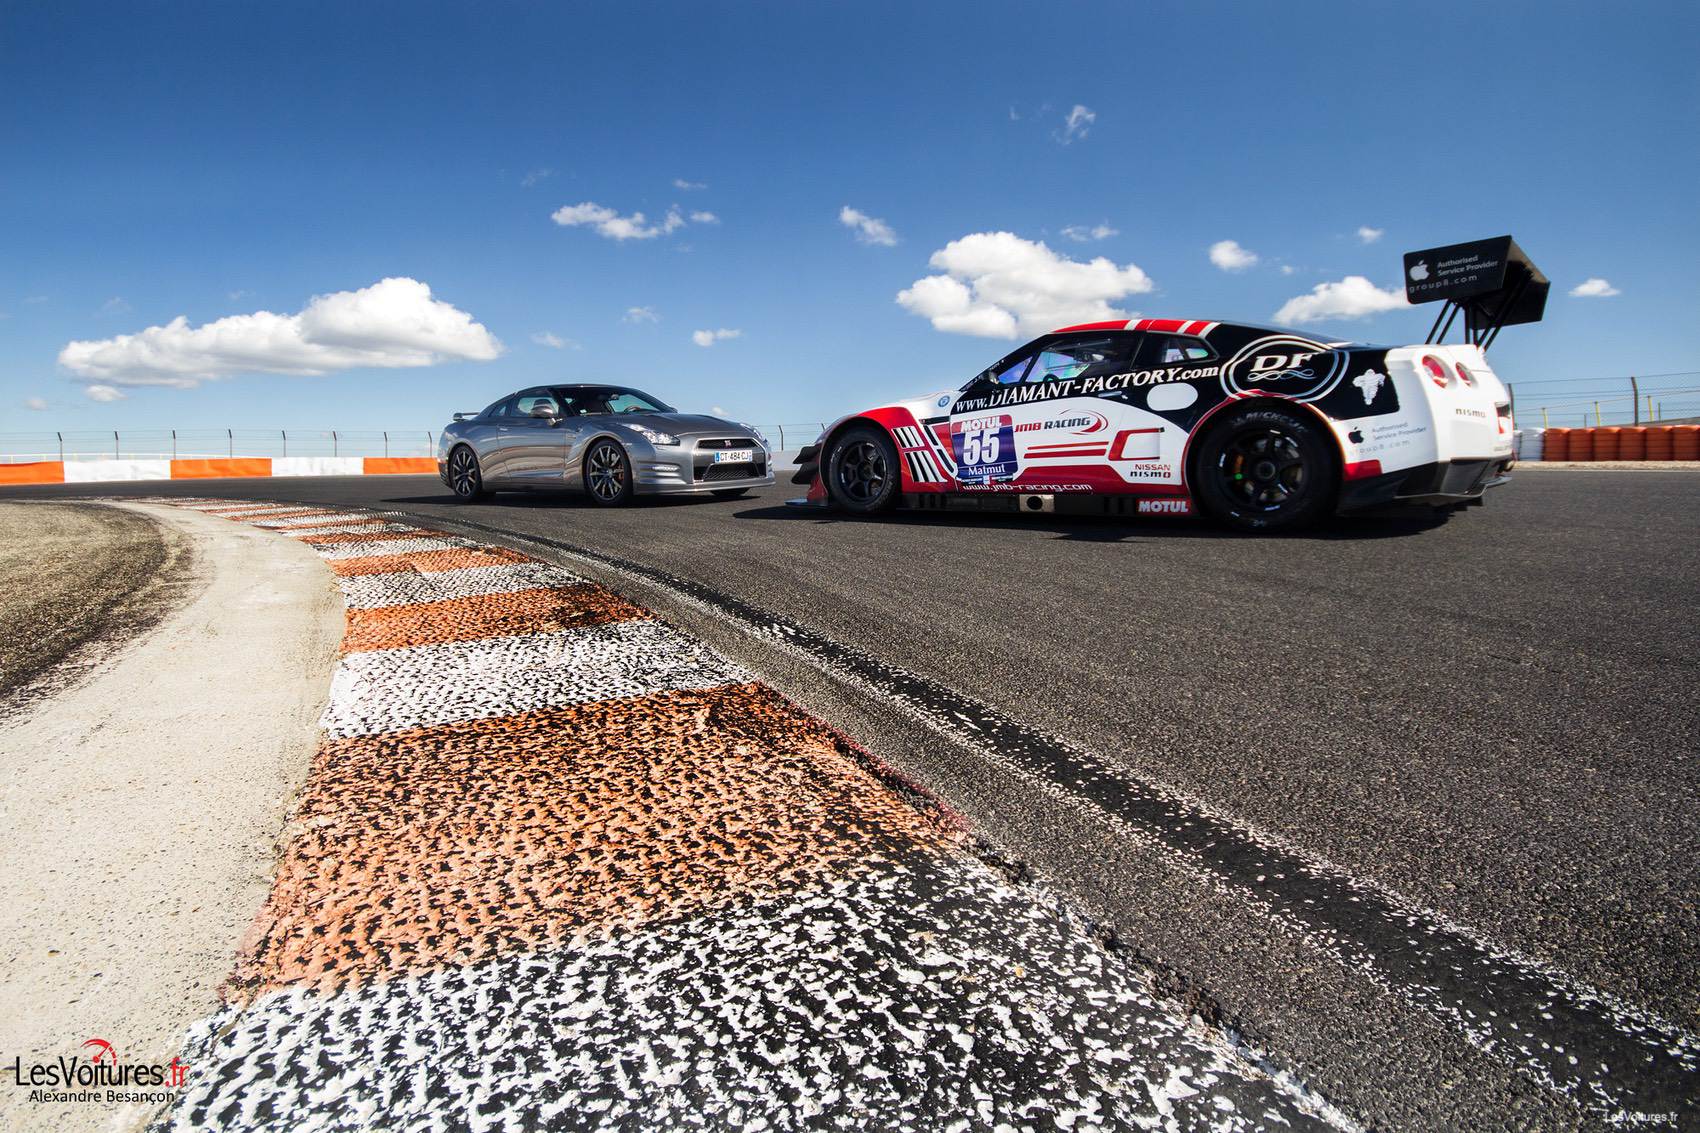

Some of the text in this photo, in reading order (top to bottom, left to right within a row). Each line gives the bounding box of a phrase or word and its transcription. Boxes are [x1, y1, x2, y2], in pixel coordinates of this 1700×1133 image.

[1437, 255, 1479, 269] Authorised
[1437, 259, 1499, 277] Service Provider
[1250, 353, 1315, 372] DF
[961, 416, 1002, 432] MOTUL
[1014, 416, 1091, 433] JMB RACING
[963, 429, 1000, 466] 55
[968, 463, 1006, 476] Matmut
[1134, 463, 1171, 471] NISSAN
[963, 482, 1093, 493] www.jmb-racing.com
[1138, 501, 1189, 513] MOTUL
